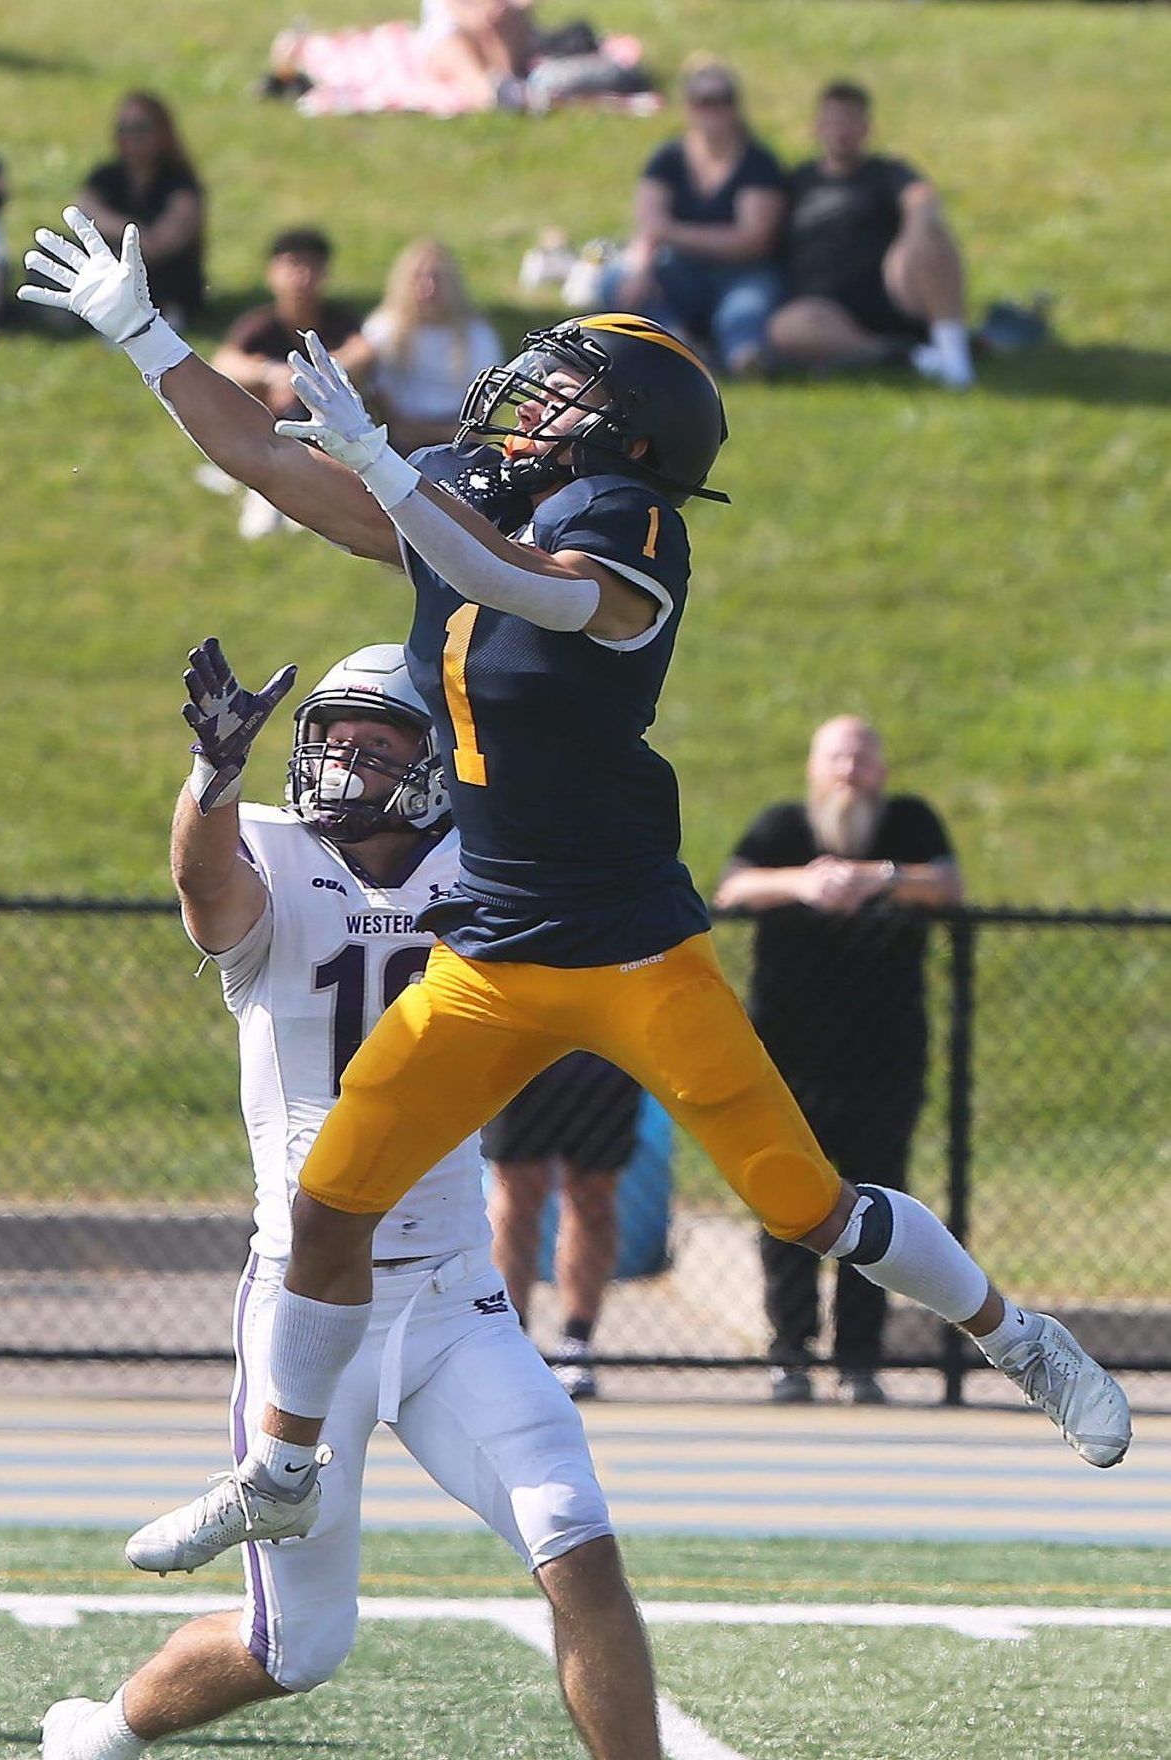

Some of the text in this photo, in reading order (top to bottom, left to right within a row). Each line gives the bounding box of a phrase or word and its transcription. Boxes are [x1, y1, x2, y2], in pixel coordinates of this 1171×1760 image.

[642, 505, 661, 560] 1
[442, 601, 488, 787] 1
[346, 915, 426, 934] WESTER
